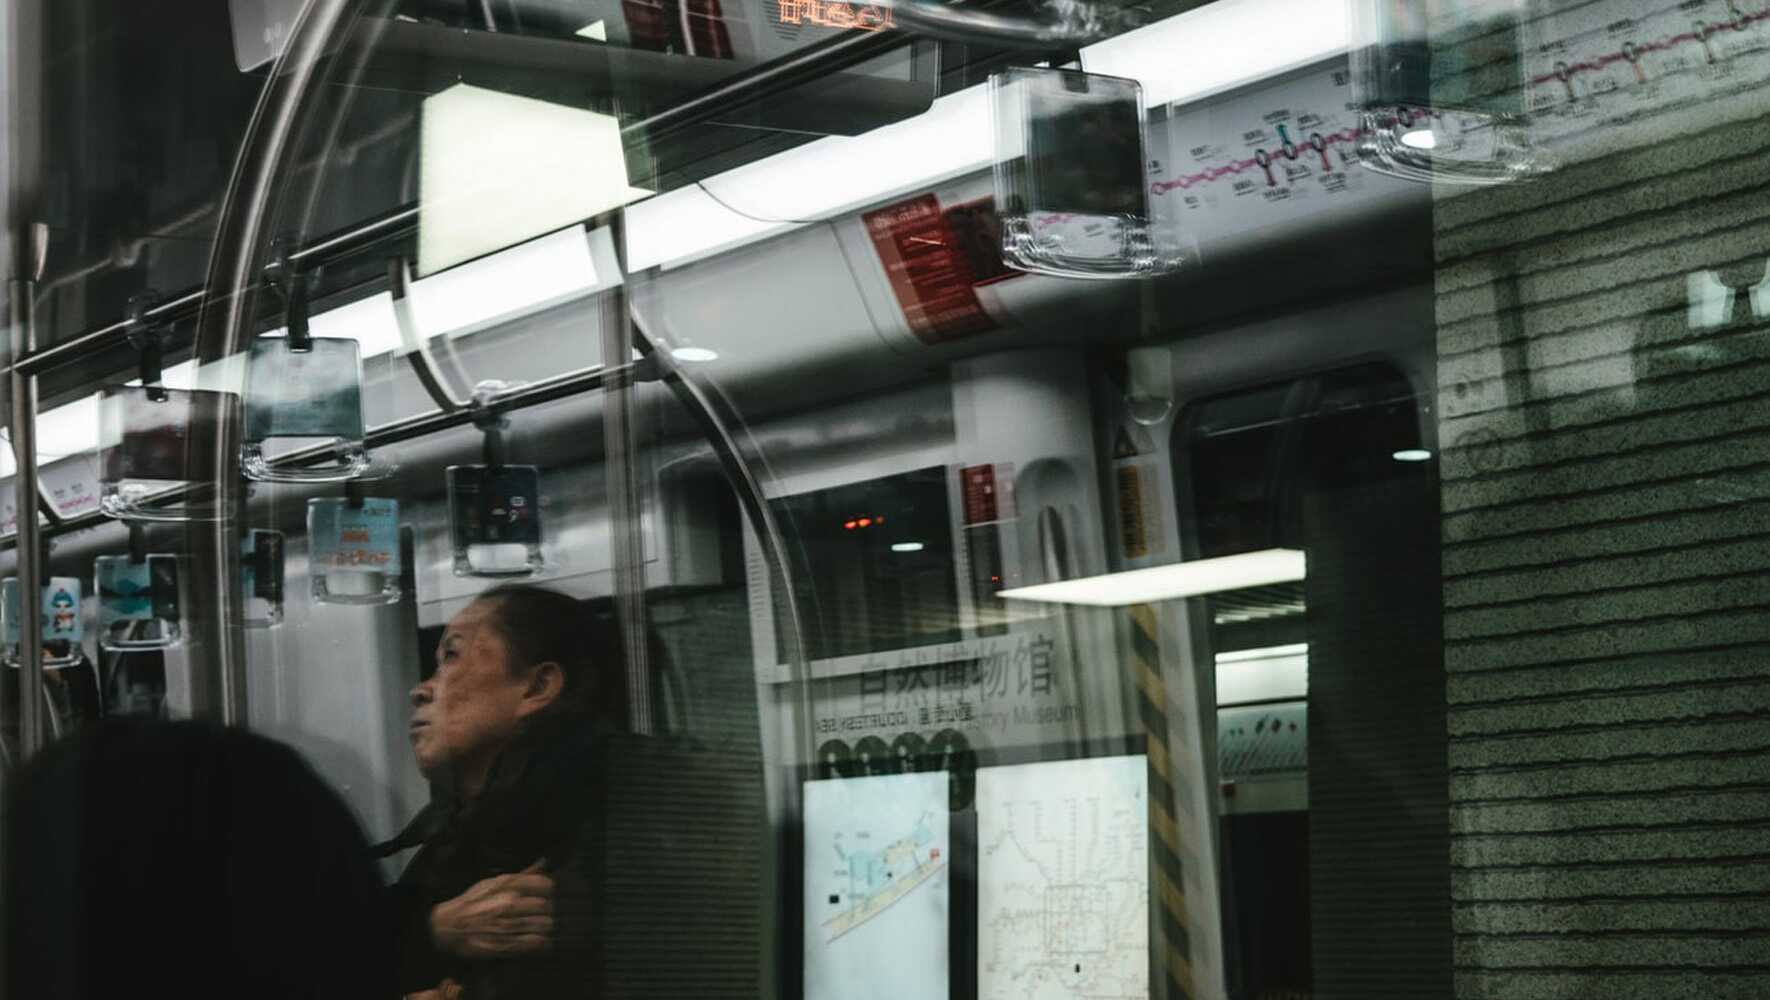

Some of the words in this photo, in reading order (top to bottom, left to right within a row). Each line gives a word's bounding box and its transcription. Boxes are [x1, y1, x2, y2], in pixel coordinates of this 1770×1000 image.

[859, 633, 1056, 711] 自然博物馆
